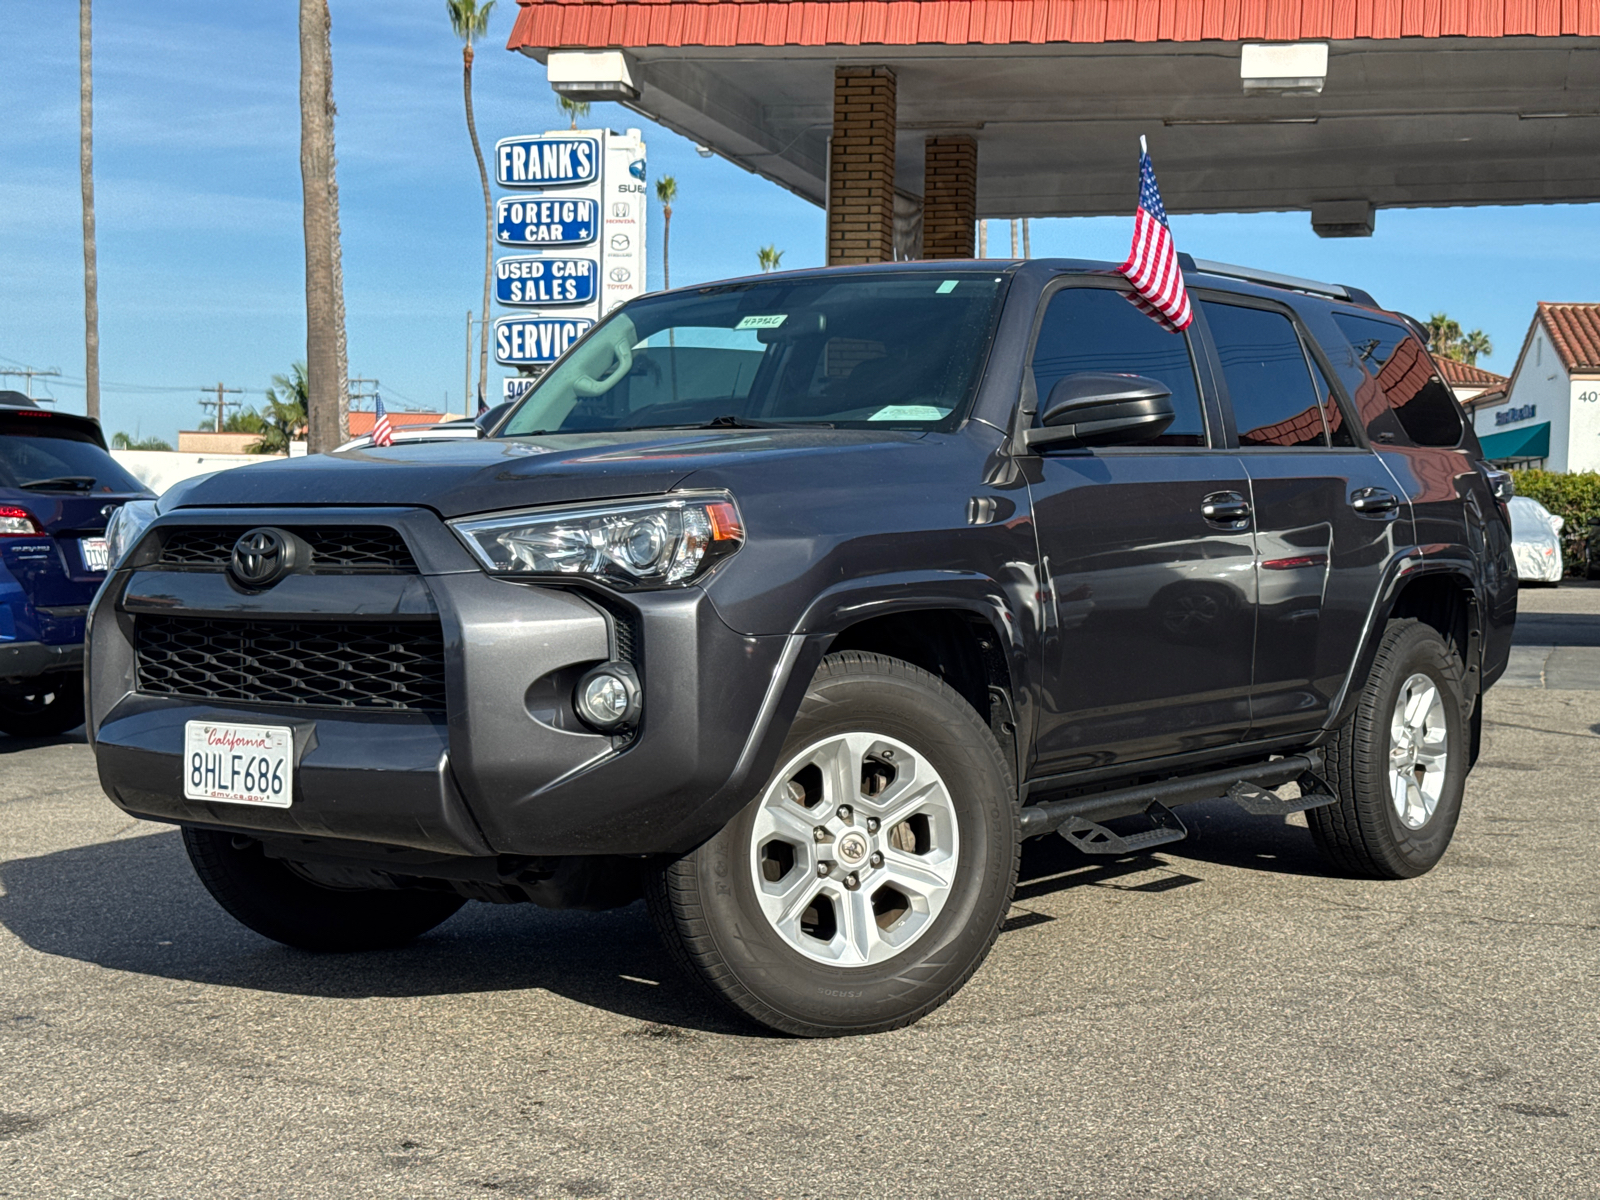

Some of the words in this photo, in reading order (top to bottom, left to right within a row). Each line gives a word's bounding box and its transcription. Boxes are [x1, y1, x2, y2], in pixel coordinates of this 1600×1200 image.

[500, 142, 591, 181] FRANK'S
[618, 184, 645, 194] SUB
[499, 202, 590, 225] FOREIGN
[525, 224, 563, 241] CAR
[498, 262, 544, 280] USED
[551, 261, 590, 277] CAR
[510, 279, 577, 301] SALES
[1578, 391, 1600, 403] 40
[207, 727, 273, 752] California
[191, 752, 284, 794] 8HLF686
[210, 790, 265, 802] dmv.ca.gov
